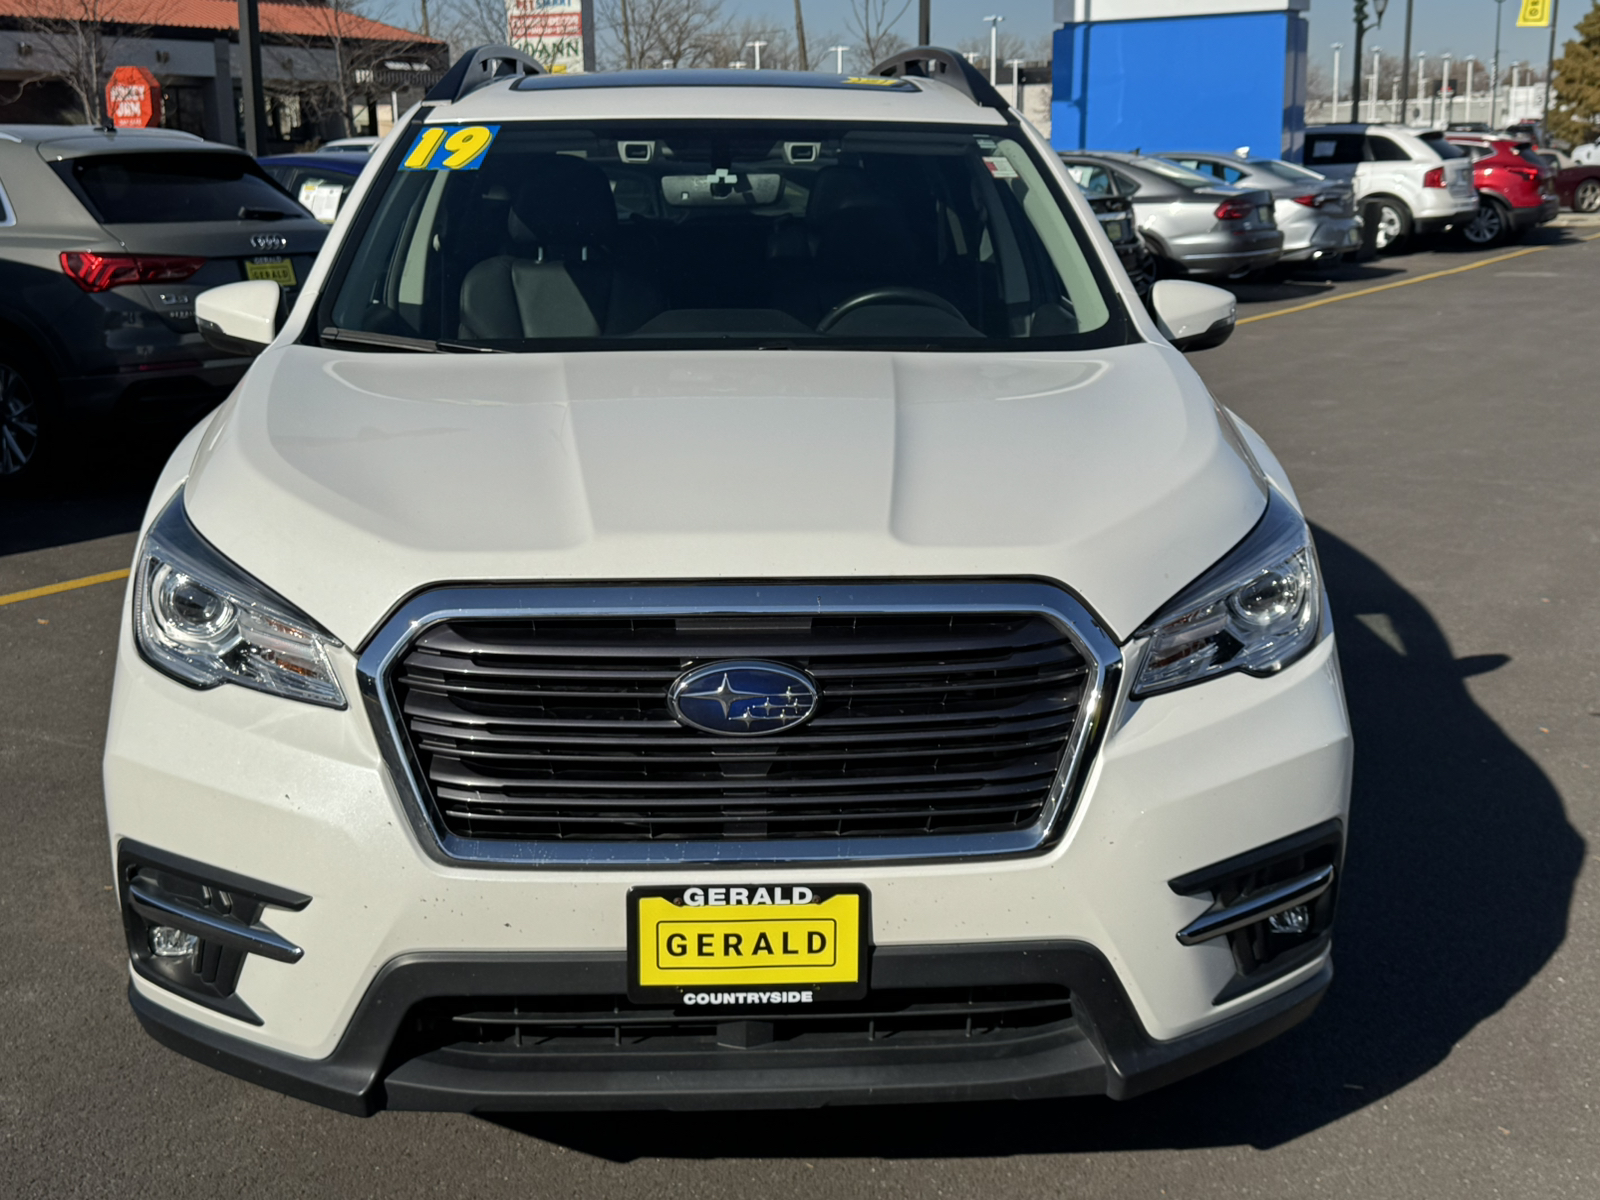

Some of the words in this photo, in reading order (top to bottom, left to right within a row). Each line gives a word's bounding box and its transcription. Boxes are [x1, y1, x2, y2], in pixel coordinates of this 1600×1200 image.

[404, 126, 492, 170] 19
[683, 887, 813, 907] GERALD
[666, 931, 827, 957] GERALD
[683, 991, 813, 1005] COUNTRYSIDE
